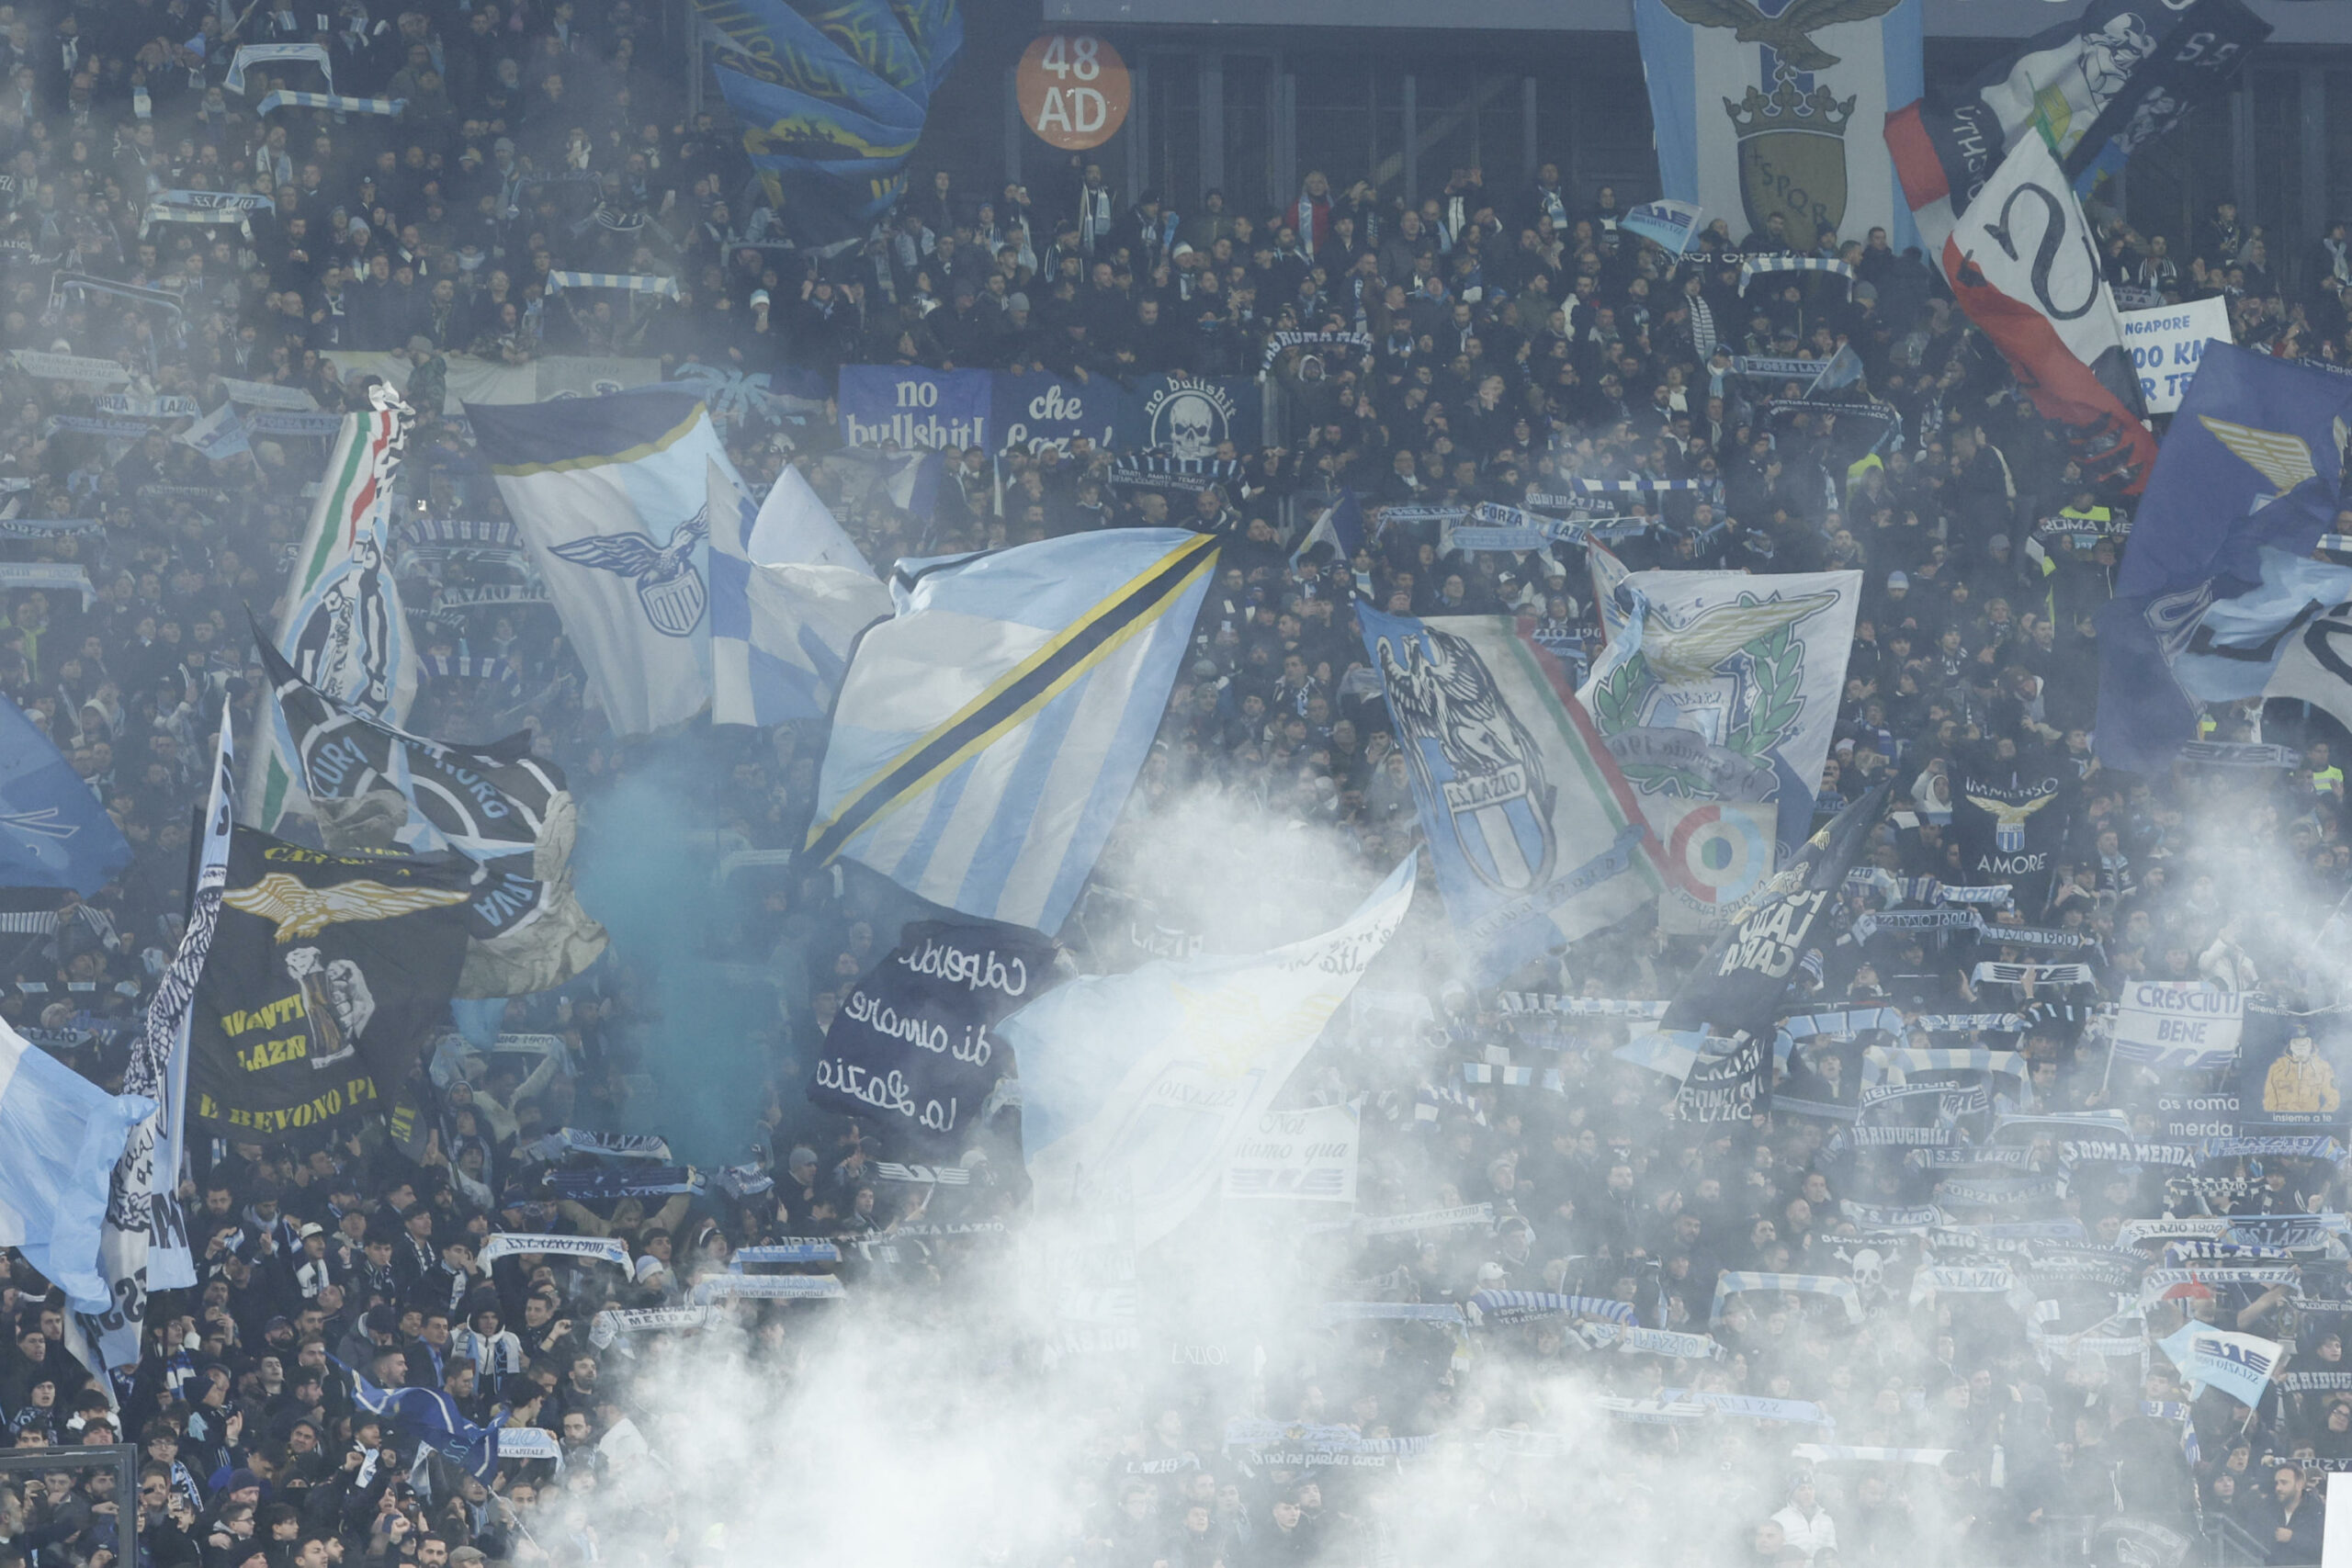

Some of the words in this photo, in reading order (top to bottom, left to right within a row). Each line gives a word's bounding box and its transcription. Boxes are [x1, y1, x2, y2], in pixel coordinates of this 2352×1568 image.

[1042, 37, 1100, 80] 48
[1036, 87, 1107, 132] AD
[2125, 315, 2190, 335] NGAPORE
[896, 380, 937, 408] no
[1028, 384, 1083, 421] che
[1145, 389, 1164, 415] no
[1167, 376, 1238, 421] bullshit
[1481, 504, 1523, 528] FORZA
[1976, 852, 2049, 874] AMORE
[2135, 985, 2241, 1014] CRESCIUTI
[2156, 1019, 2208, 1044] BENE
[229, 1089, 343, 1134] BEVONO
[2159, 1097, 2181, 1111] as
[2187, 1096, 2240, 1111] roma
[2168, 1119, 2233, 1138] merda
[2272, 1112, 2311, 1122] insieme
[2322, 1113, 2333, 1122] te
[1851, 1128, 1951, 1145] IRRIDUCIBILI
[1304, 1141, 1349, 1165] qua
[1936, 1149, 1964, 1162] S.S.
[1975, 1150, 2022, 1163] LAZIO
[2077, 1139, 2132, 1160] ROMA
[2134, 1144, 2198, 1169] MERDA
[2215, 1180, 2248, 1191] LAZIO
[1891, 1210, 1933, 1225] LAZIO
[2151, 1223, 2188, 1236] LAZIO
[2190, 1222, 2223, 1236] 1900
[628, 1314, 693, 1327] MERDA
[1633, 1329, 1700, 1359] LAZIO
[497, 1428, 542, 1447] ZIO
[509, 1447, 545, 1456] CAPITALE
